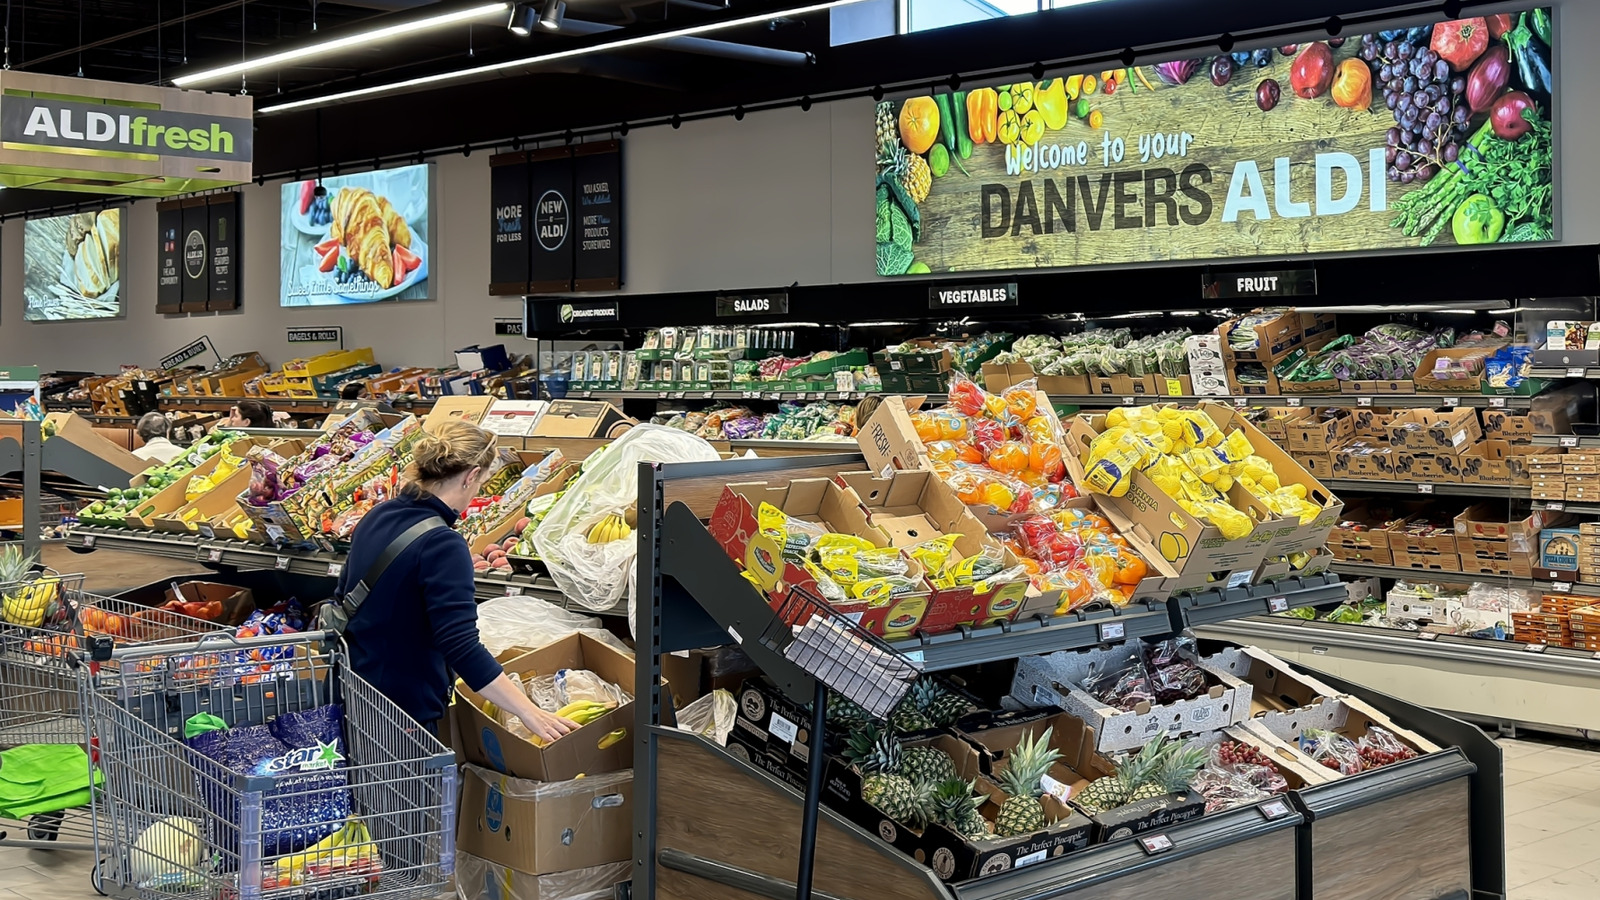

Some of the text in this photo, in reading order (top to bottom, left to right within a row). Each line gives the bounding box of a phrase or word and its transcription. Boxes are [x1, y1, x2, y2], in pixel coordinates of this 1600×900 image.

[23, 106, 234, 153] ALDIfresh
[1005, 130, 1194, 176] Welcome to your
[583, 184, 593, 194] YOU
[981, 147, 1388, 239] DANVERS ALDI
[496, 205, 522, 220] MORE
[541, 200, 563, 215] NEW
[583, 215, 597, 226] MORE
[496, 232, 522, 243] FOR LESS
[540, 224, 564, 239] ALDI
[584, 226, 609, 238] PRODUCTS
[287, 275, 379, 298] Sweet Little Somethings
[1236, 276, 1279, 293] FRUIT
[938, 288, 1007, 305] VEGETABLES
[593, 308, 615, 316] PRODUCE
[734, 298, 770, 313] SALADS
[289, 333, 312, 341] BAGELS
[318, 332, 336, 340] ROLLS
[507, 324, 523, 334] PAS
[163, 343, 205, 370] BREAD & BUNS
[872, 423, 890, 456] FRESH
[1126, 491, 1147, 512] ONS
[1130, 482, 1159, 512] ORNIA
[770, 698, 780, 712] The
[780, 705, 801, 723] Perfect
[269, 747, 321, 770] star
[302, 760, 327, 769] market
[755, 752, 765, 765] The
[766, 760, 786, 779] Perfect
[1138, 807, 1199, 830] The Perfect Pineapple
[1016, 831, 1085, 856] The Perfect Pineapple
